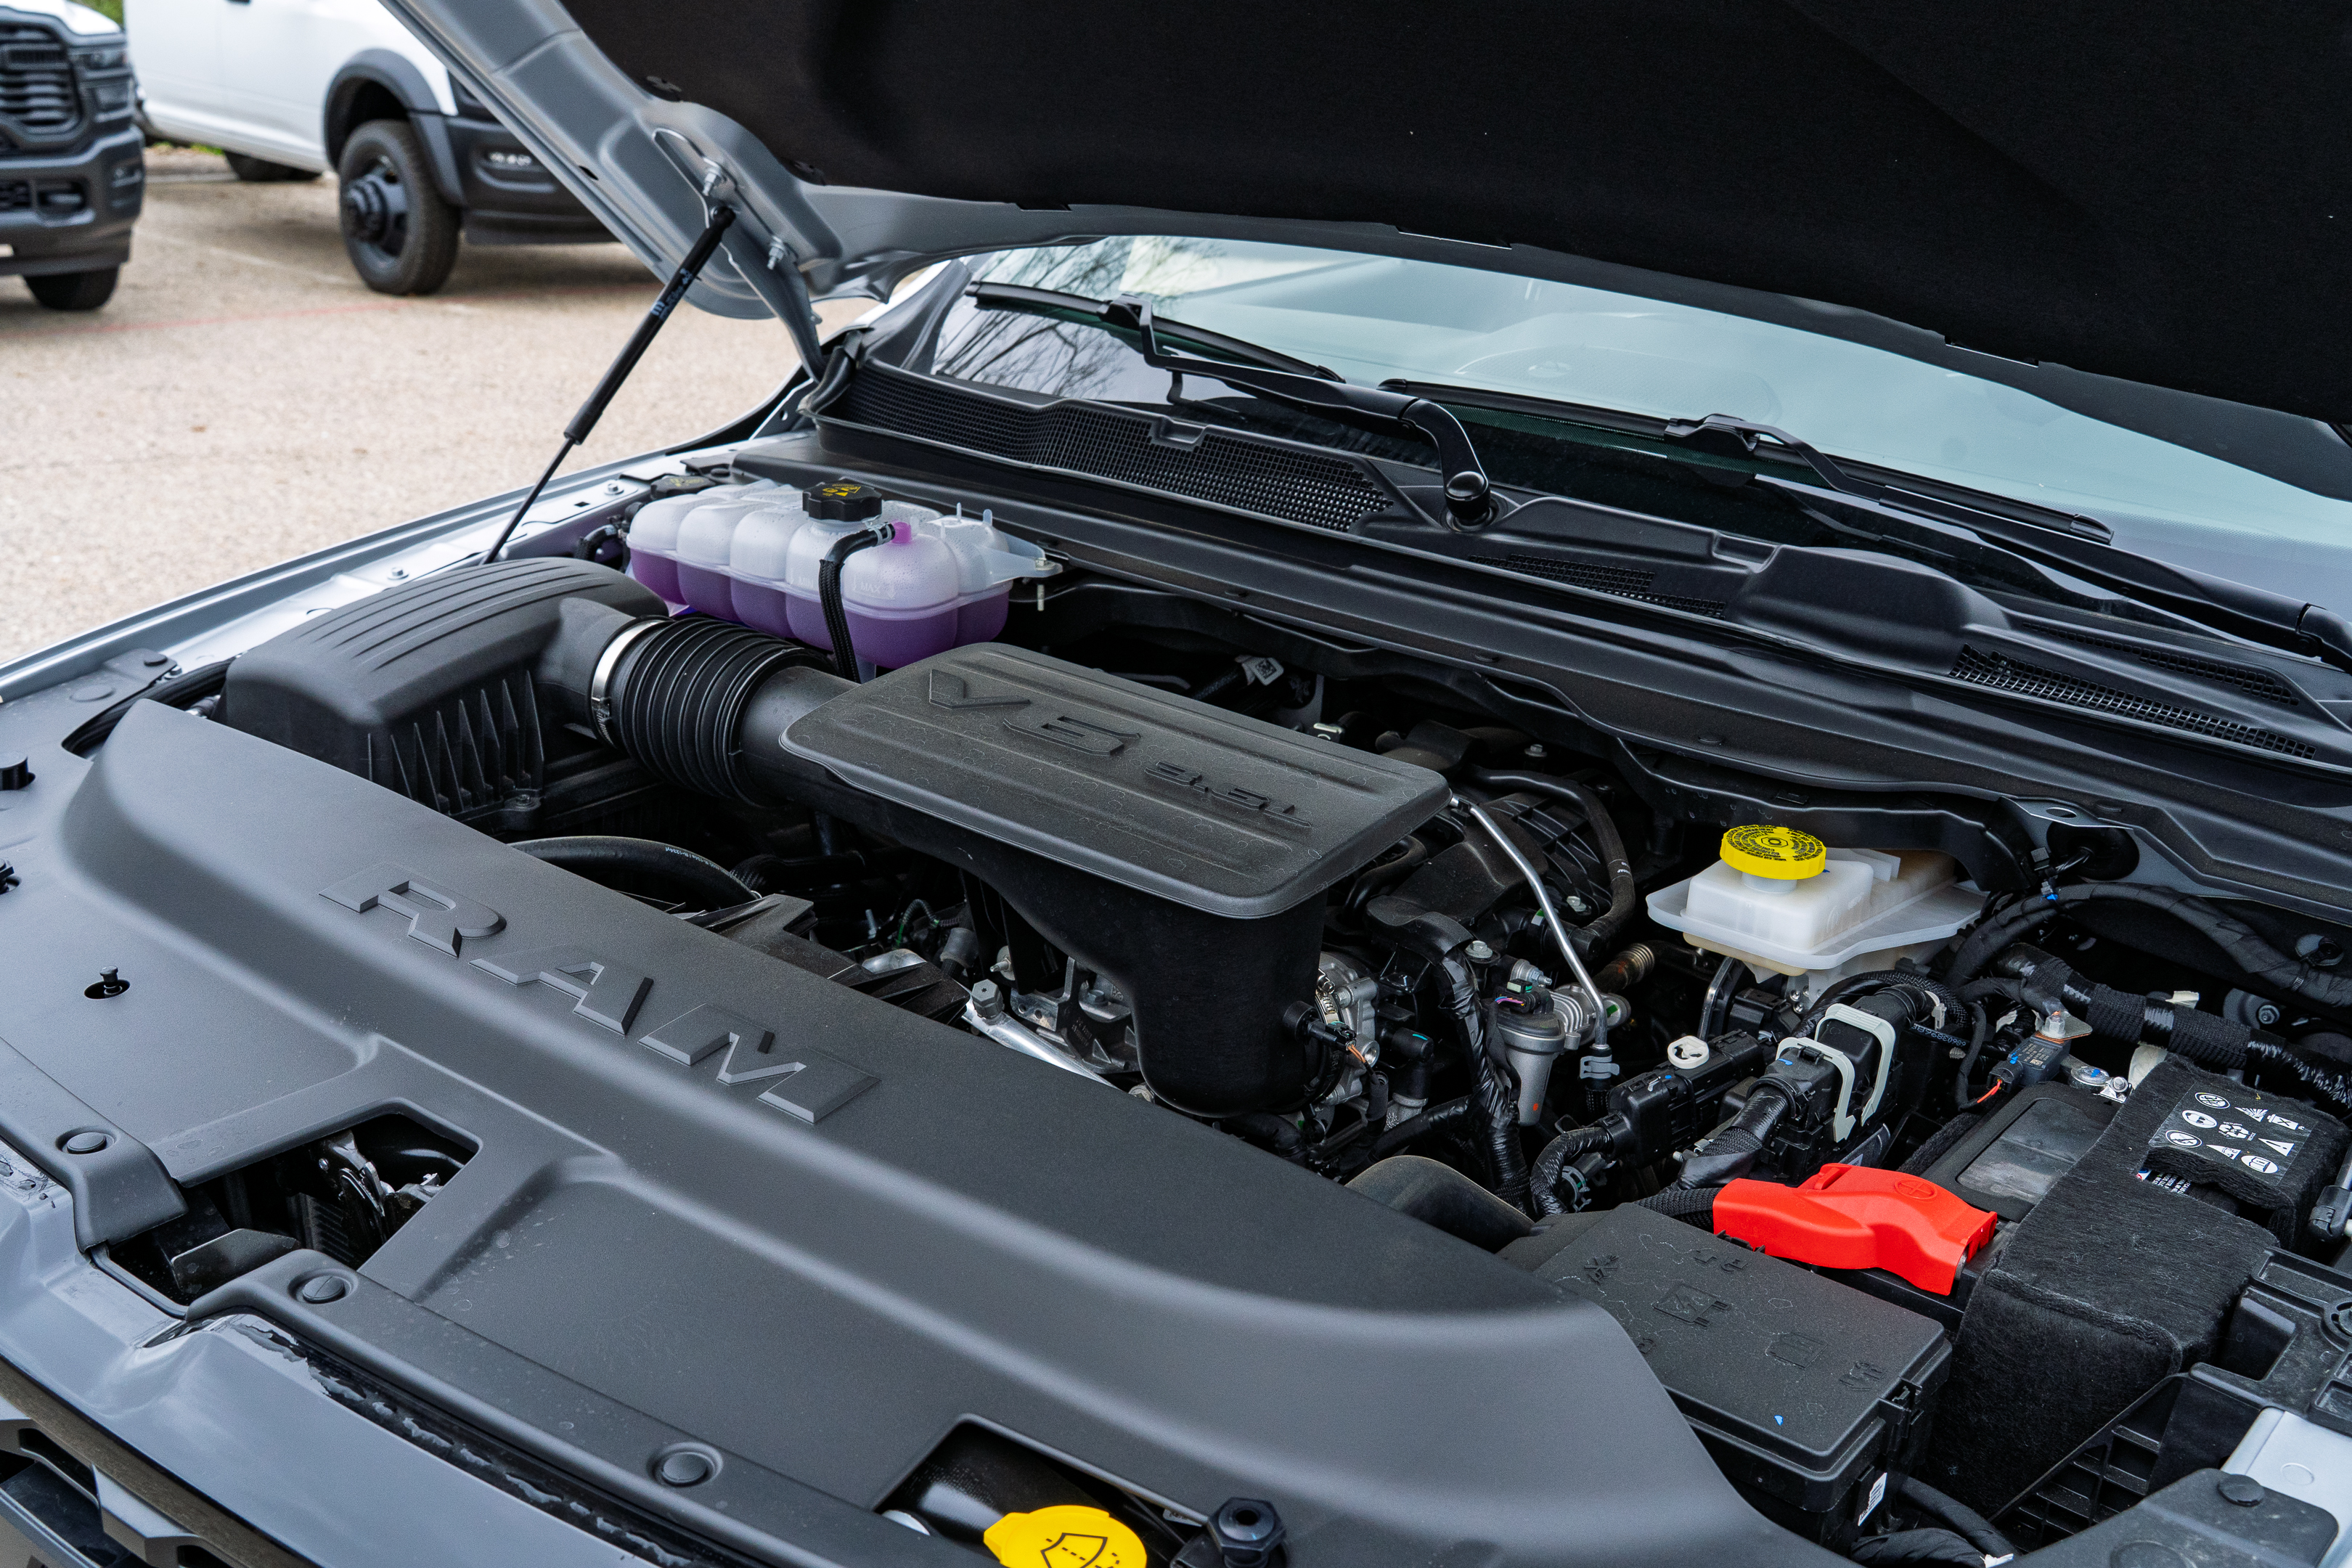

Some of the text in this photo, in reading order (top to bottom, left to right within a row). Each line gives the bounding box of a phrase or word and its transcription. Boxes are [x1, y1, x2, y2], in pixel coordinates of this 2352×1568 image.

[860, 581, 881, 595] MAX
[927, 668, 1313, 829] V6 3.6L
[317, 861, 882, 1124] RAM
